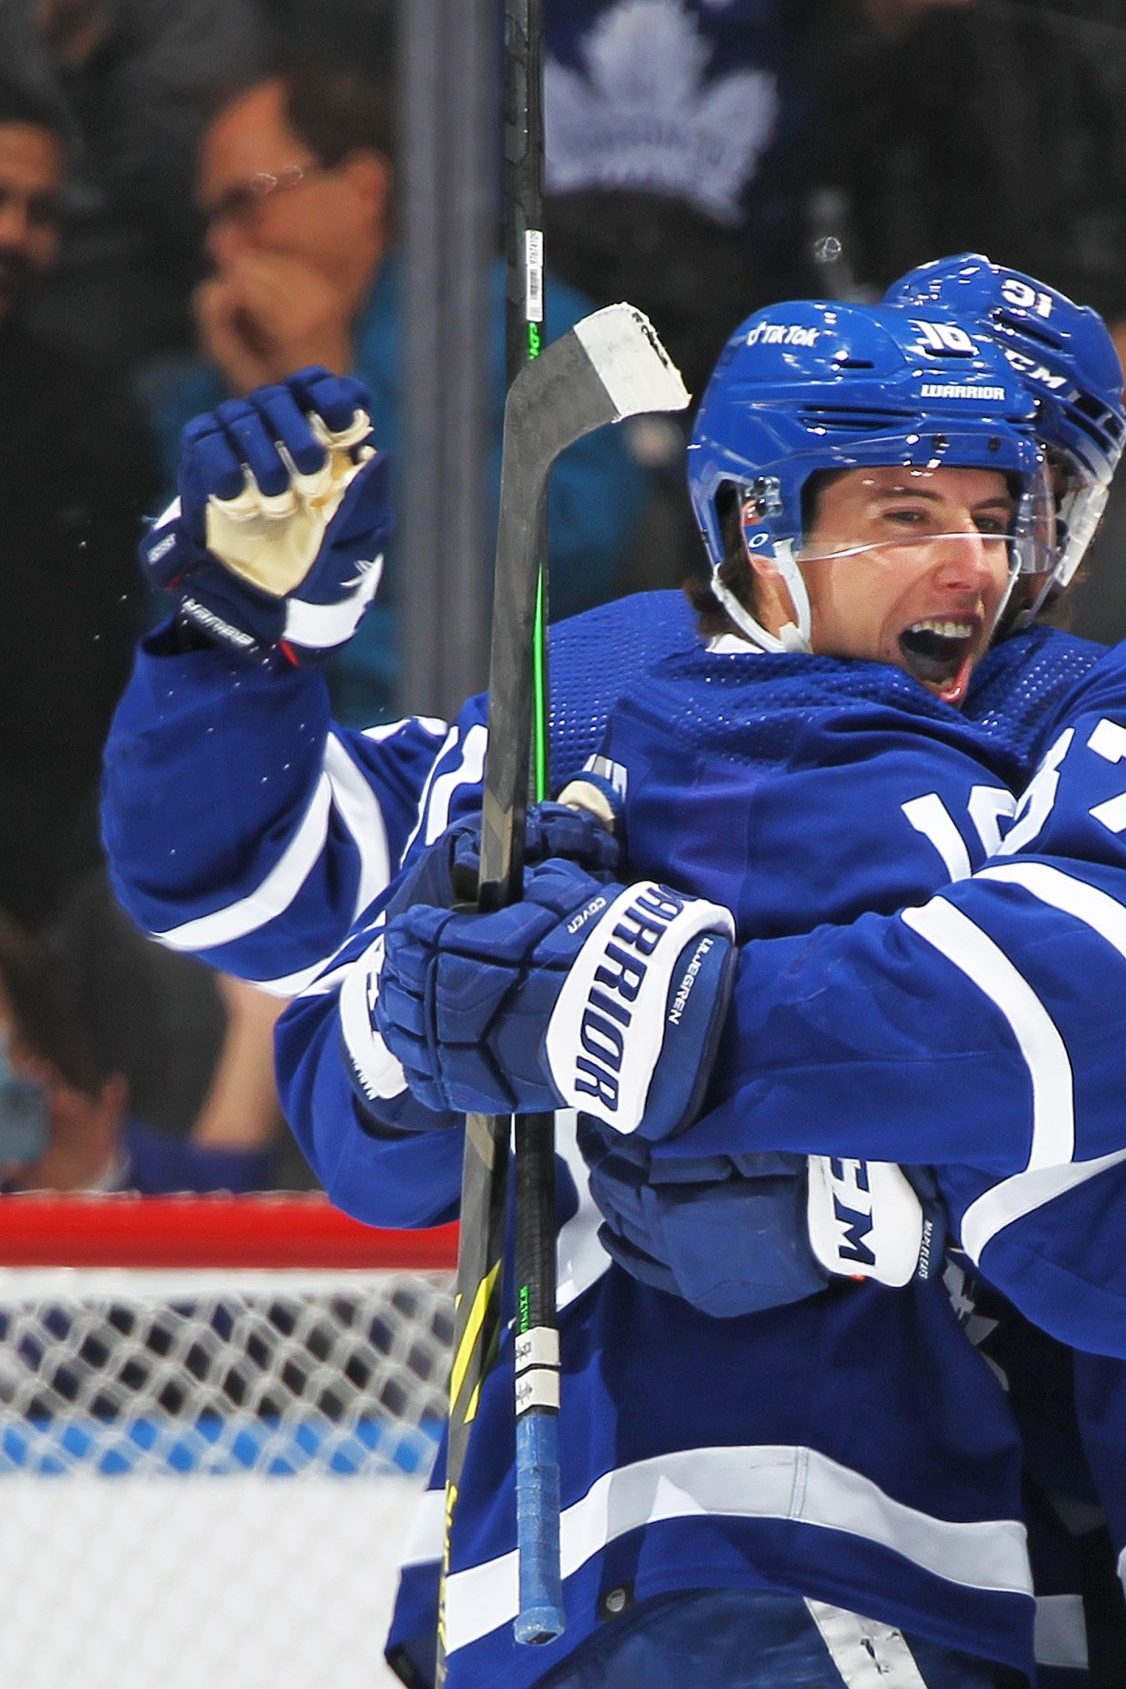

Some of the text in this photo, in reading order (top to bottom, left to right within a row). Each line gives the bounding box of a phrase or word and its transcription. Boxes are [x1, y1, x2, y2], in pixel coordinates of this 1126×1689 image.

[1001, 278, 1053, 318] 91
[1003, 347, 1068, 390] CM
[920, 383, 1006, 401] WARRIOR
[566, 896, 607, 935] COVER
[574, 884, 692, 1113] ARRIOR
[668, 937, 715, 1026] LILJEGREN
